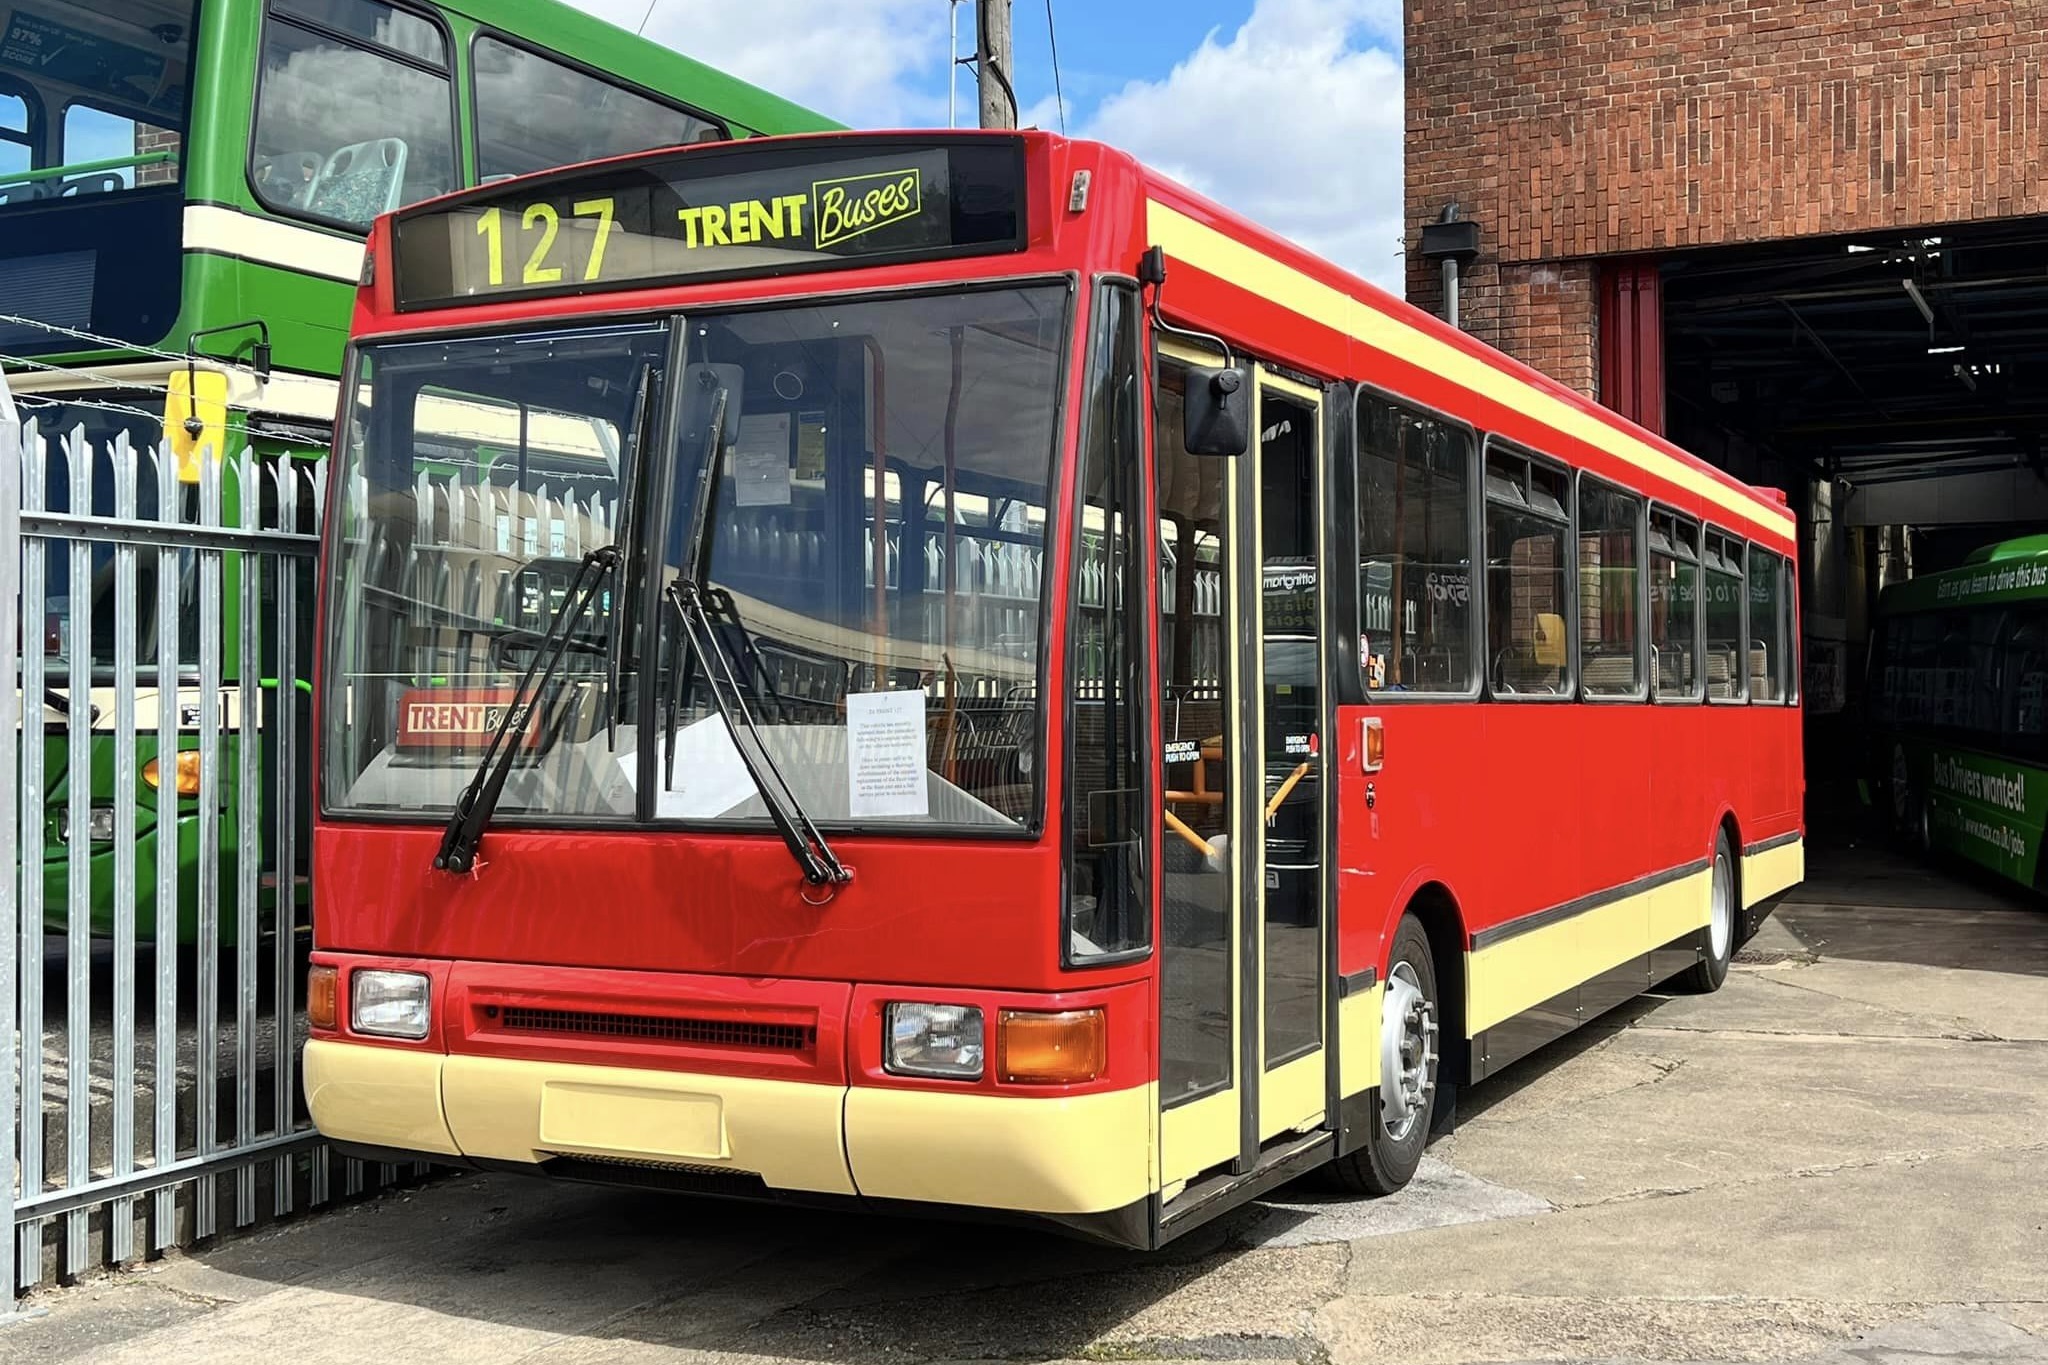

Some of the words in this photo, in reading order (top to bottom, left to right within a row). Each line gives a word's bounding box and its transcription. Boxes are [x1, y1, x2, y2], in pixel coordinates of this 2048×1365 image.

[11, 27, 43, 47] 97%
[1, 49, 35, 66] SCORE
[678, 194, 807, 249] TRENT
[820, 176, 914, 241] Buses
[475, 197, 615, 286] 127
[1996, 566, 2015, 590] drive
[2016, 562, 2031, 589] this
[2031, 561, 2048, 587] bus
[410, 706, 484, 730] TRENT
[1165, 741, 1196, 753] EMERGENCY
[1165, 752, 1179, 764] PUSH
[1179, 752, 1186, 762] TO
[1186, 750, 1200, 761] OPEN
[1933, 753, 1949, 789] Bus
[1949, 757, 1981, 800] Drivers
[1982, 772, 2025, 815] wanted!
